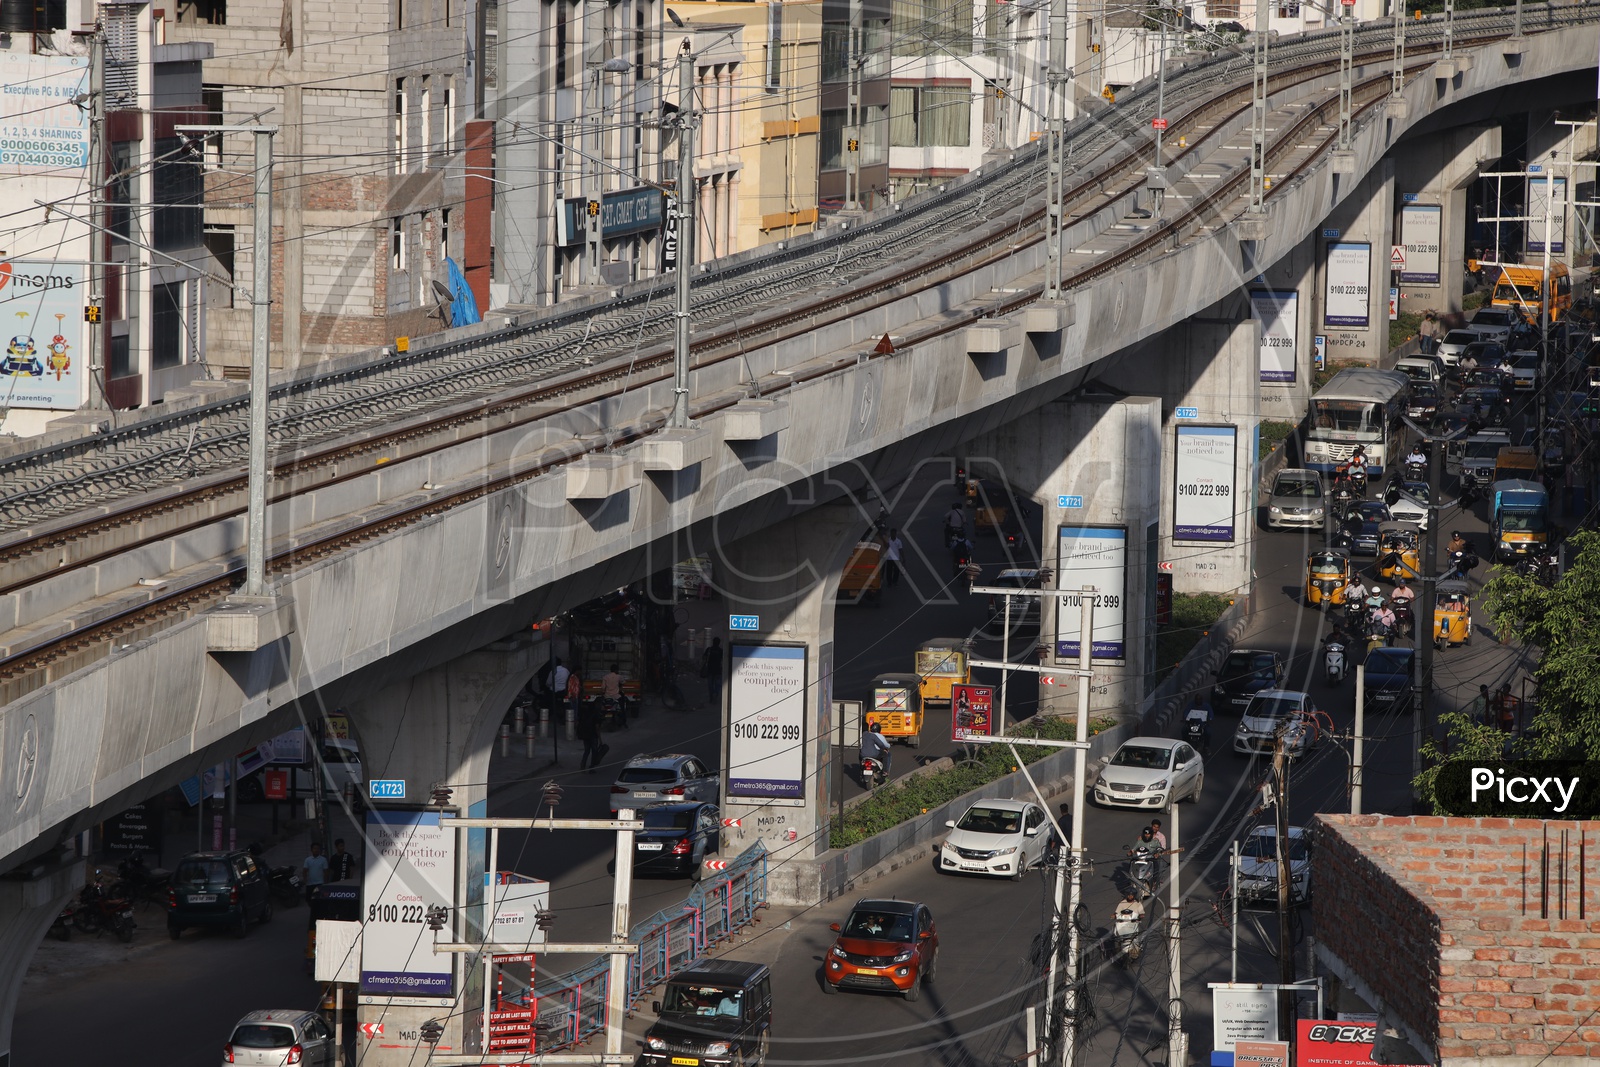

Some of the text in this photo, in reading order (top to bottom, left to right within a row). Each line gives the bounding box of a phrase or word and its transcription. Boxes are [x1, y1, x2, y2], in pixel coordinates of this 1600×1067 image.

[4, 84, 40, 96] Executive
[42, 86, 52, 97] PG
[54, 87, 60, 96] &
[32, 129, 37, 137] 4
[40, 128, 82, 140] SHARINGS
[2, 152, 80, 166] 9704403994
[1428, 245, 1438, 253] 999
[13, 273, 73, 289] moms
[1330, 286, 1368, 294] 9100 222 999
[1269, 338, 1280, 347] 222
[1282, 338, 1292, 347] 999
[1194, 438, 1214, 446] brand
[1178, 484, 1230, 496] 9100 222 999
[1066, 498, 1081, 506] 1721
[1079, 542, 1102, 551] brand
[1072, 551, 1100, 560] noticed
[1104, 595, 1120, 608] 999
[732, 618, 757, 628] C 1722
[744, 676, 798, 687] competitor
[734, 724, 800, 740] 9100 222 999
[372, 784, 403, 794] C 1723
[734, 783, 798, 792] cfmetro365@gmail.com
[380, 830, 442, 840] Book this space
[373, 839, 418, 849] before your
[381, 846, 448, 860] competitor
[414, 858, 436, 868] does
[396, 894, 422, 902] Contact
[369, 904, 398, 922] 9100
[402, 905, 423, 923] 222
